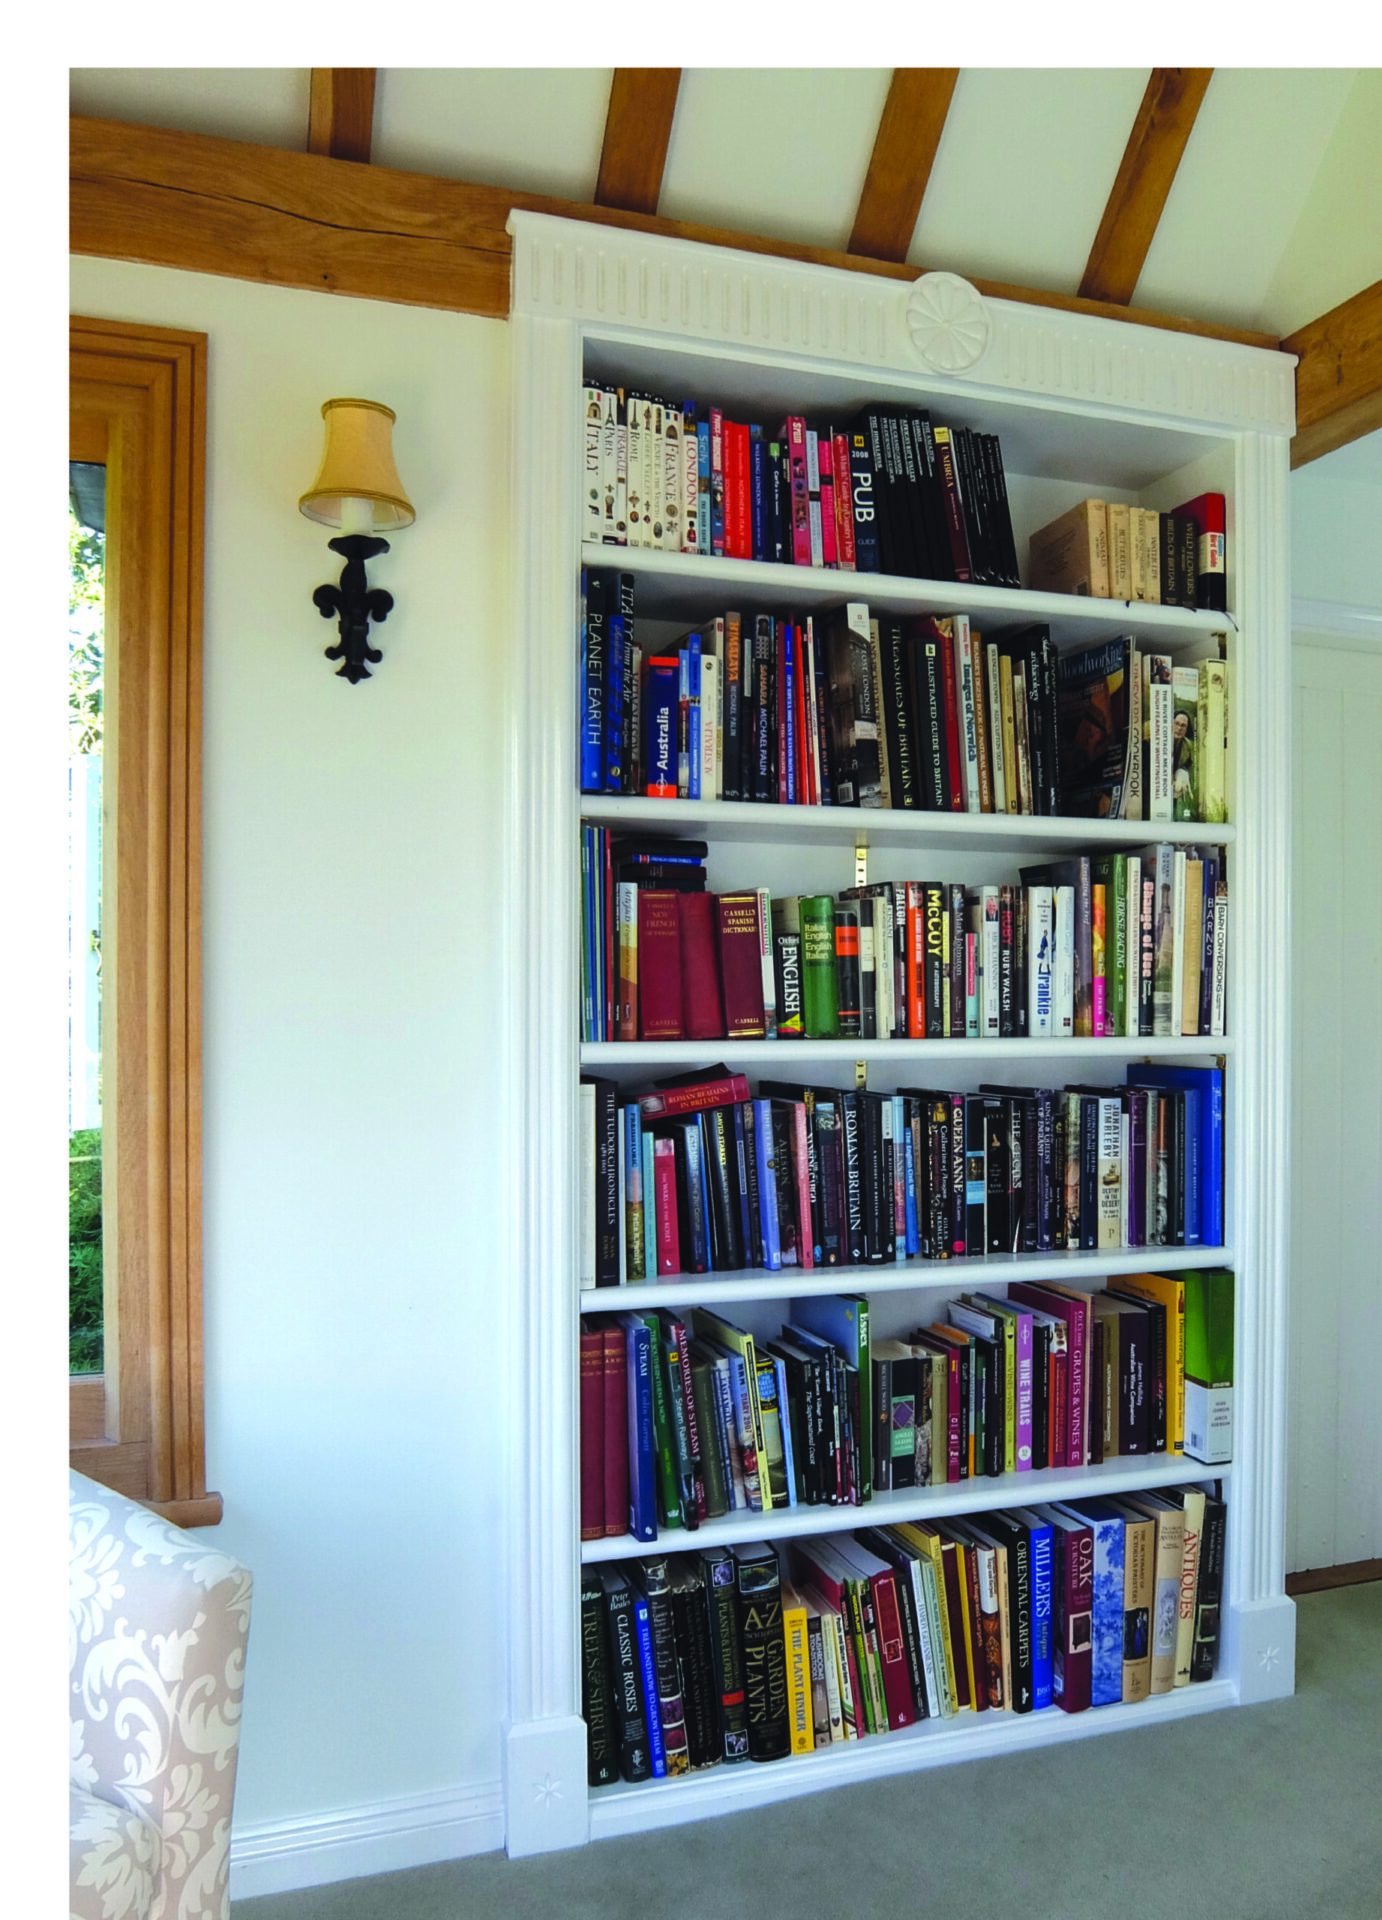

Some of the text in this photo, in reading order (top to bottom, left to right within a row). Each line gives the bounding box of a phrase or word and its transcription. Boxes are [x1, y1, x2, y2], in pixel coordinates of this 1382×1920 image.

[586, 422, 602, 476] ITALY
[604, 427, 616, 456] PARIS
[617, 428, 625, 475] PRAGUE
[630, 432, 640, 462] ROME
[698, 435, 708, 464] Sicily
[941, 446, 954, 487] UMBRIA
[665, 442, 678, 500] FRANCE
[686, 440, 698, 508] LONDON
[852, 473, 874, 522] PUB
[1186, 551, 1194, 595] FLOWERS
[622, 641, 632, 666] from
[624, 668, 632, 685] the
[729, 622, 739, 681] HIMALAYA
[588, 613, 602, 744] PLANET EARTH
[623, 687, 632, 703] Air
[760, 664, 768, 705] SAHARA
[862, 678, 871, 714] LONDON
[657, 707, 668, 770] Australia
[760, 708, 768, 747] MICHAEL
[927, 657, 943, 806] ILLUSTRATED GUIDE TO BRITAIN
[962, 664, 977, 762] Images of Norwich
[705, 721, 713, 776] AUSTRALIA
[896, 889, 905, 925] FALLON
[928, 890, 942, 957] McCOY
[1116, 897, 1125, 968] HORSE RACING
[1140, 882, 1154, 930] Change
[783, 947, 800, 1012] ENGLISH
[955, 937, 963, 976] Johnston
[1002, 910, 1012, 1011] RUBY RUBY WALSH
[1216, 934, 1224, 992] CONVERSIONS
[953, 1108, 963, 1192] QUEEN ANNE
[1104, 1104, 1112, 1157] DIMBLEBY
[747, 1133, 758, 1208] ROMAN CHESTER
[779, 1140, 788, 1185] ALISON
[846, 1110, 860, 1230] ROMAN BRITAIN
[639, 1342, 649, 1376] STEAM
[658, 1406, 666, 1424] NOW
[678, 1329, 699, 1453] MEMORIES OF STEAM
[1020, 1359, 1031, 1425] WINE TRAILS
[1071, 1350, 1082, 1445] GRAPES & WINES
[1128, 1391, 1136, 1425] Companion
[1136, 1382, 1144, 1406] Halliday
[675, 1398, 688, 1461] Steam Railways
[1071, 1541, 1079, 1589] FURNITURE
[1079, 1537, 1092, 1588] OAK
[1179, 1529, 1197, 1620] ANTIQUES
[718, 1602, 729, 1640] PLANTS
[1017, 1541, 1029, 1668] ORIENTAL CARPETS
[617, 1614, 638, 1712] CLASSIC ROSES
[642, 1628, 650, 1649] TREES
[1040, 1620, 1049, 1659] Antiques
[583, 1607, 607, 1760] TREES & SHRUBS
[722, 1648, 733, 1691] FLOWERS
[746, 1646, 767, 1723] PLANTS
[766, 1639, 785, 1719] GARDEN
[792, 1628, 806, 1732] THE PLANT FINDER
